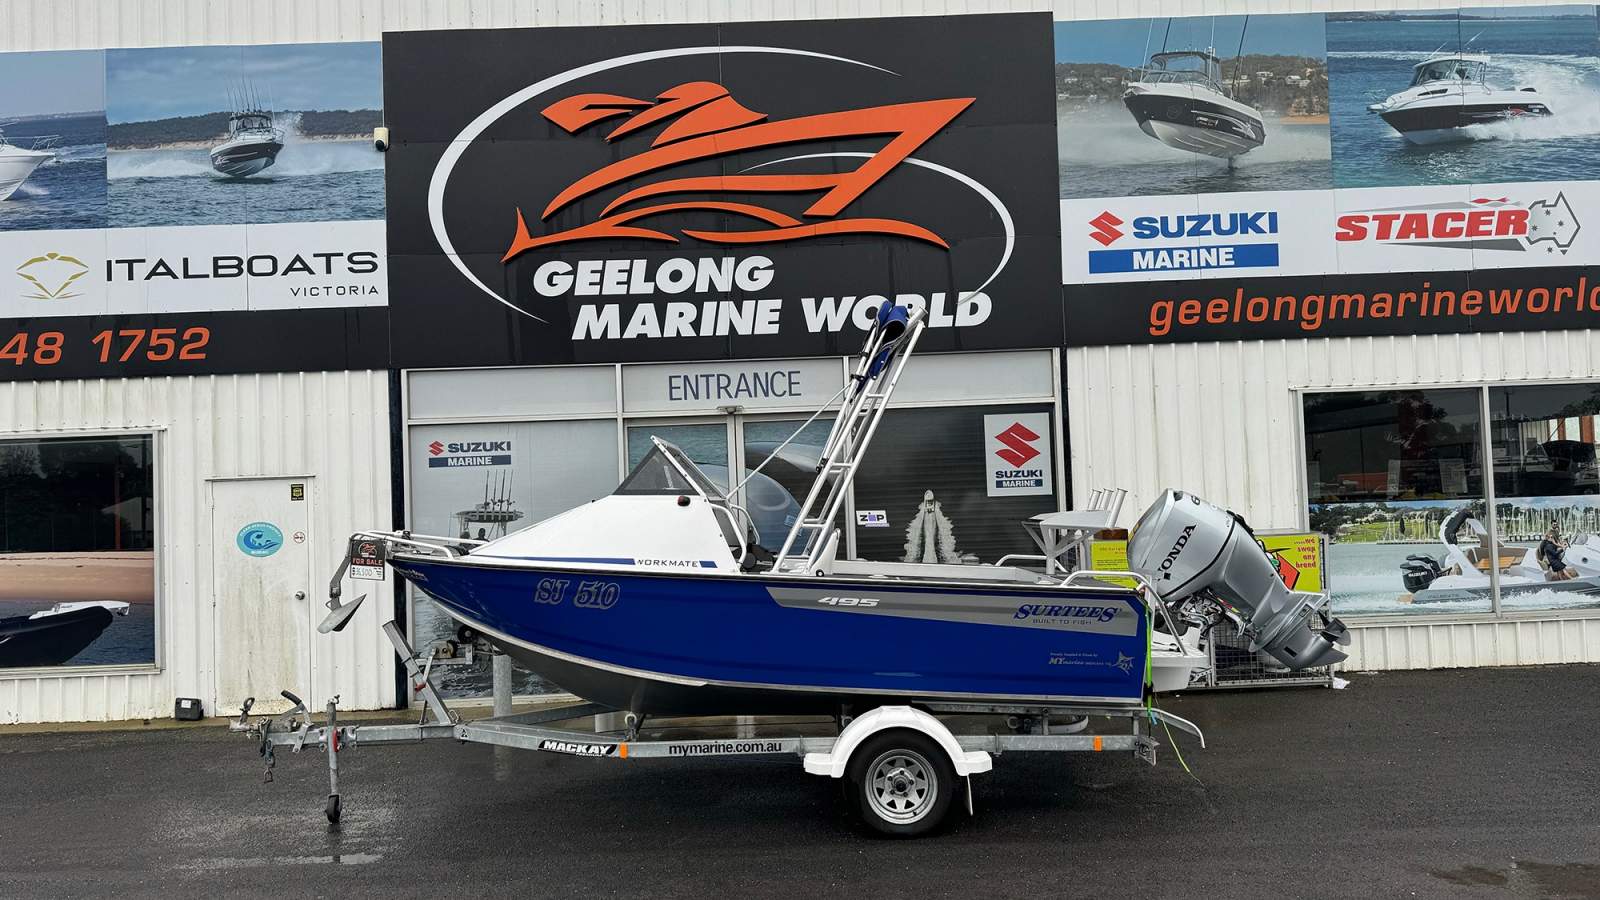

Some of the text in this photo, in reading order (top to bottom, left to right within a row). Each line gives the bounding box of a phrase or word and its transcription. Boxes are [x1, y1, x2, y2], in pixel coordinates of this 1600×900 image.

[1133, 211, 1278, 240] SUZUKI
[1335, 208, 1530, 242] STACER
[106, 251, 379, 283] ITALBOATS
[1133, 246, 1235, 270] MARINE
[533, 255, 775, 297] GEELONG
[290, 285, 379, 297] VICTORIA
[571, 298, 783, 340] MARINE
[0, 326, 210, 365] 48 1752
[668, 370, 802, 401] ENTRANCE
[447, 441, 511, 453] SUZUKI
[447, 456, 493, 467] MARINE
[995, 469, 1043, 479] SUZUKI
[1002, 479, 1036, 488] MARINE
[534, 578, 621, 610] SJ 510
[818, 597, 881, 607] 495
[1014, 603, 1118, 623] SURTEES
[543, 740, 611, 755] MACKAY
[668, 741, 783, 757] mymarine.com.au
